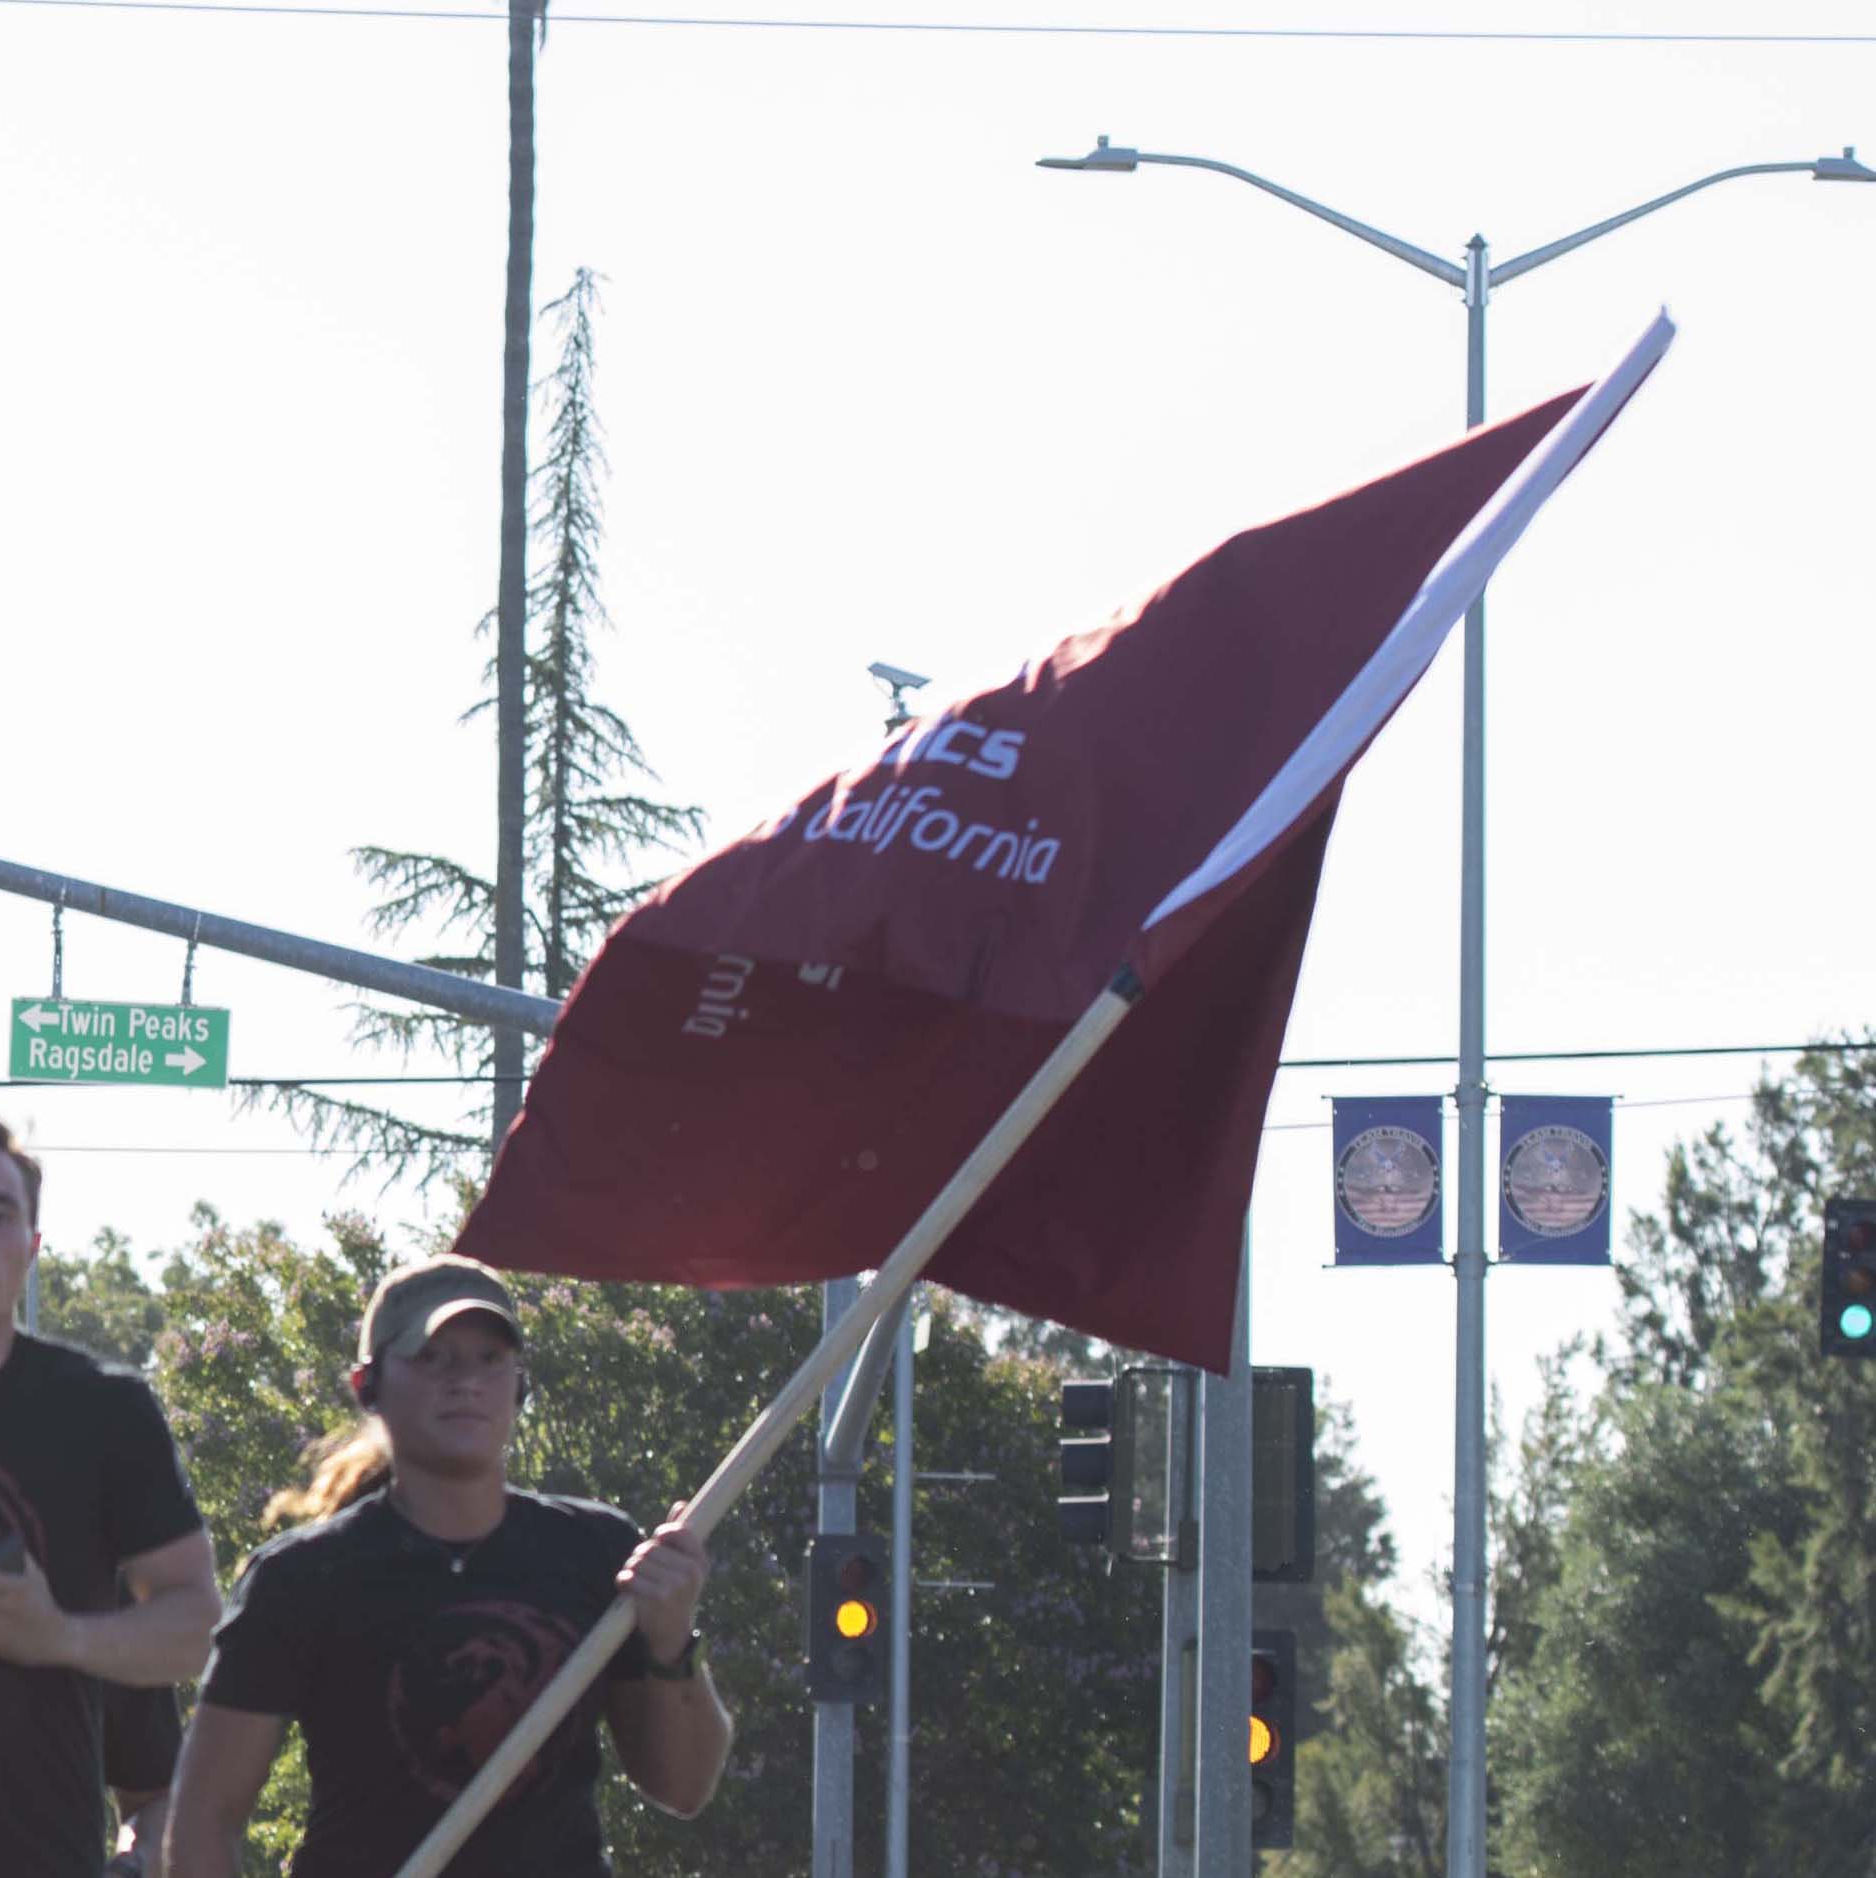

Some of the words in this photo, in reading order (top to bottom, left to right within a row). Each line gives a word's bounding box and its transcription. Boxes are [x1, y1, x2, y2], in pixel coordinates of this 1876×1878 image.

[58, 1004, 116, 1037] Twin
[129, 1007, 210, 1042] Peaks
[29, 1037, 153, 1079] Ragsdale
